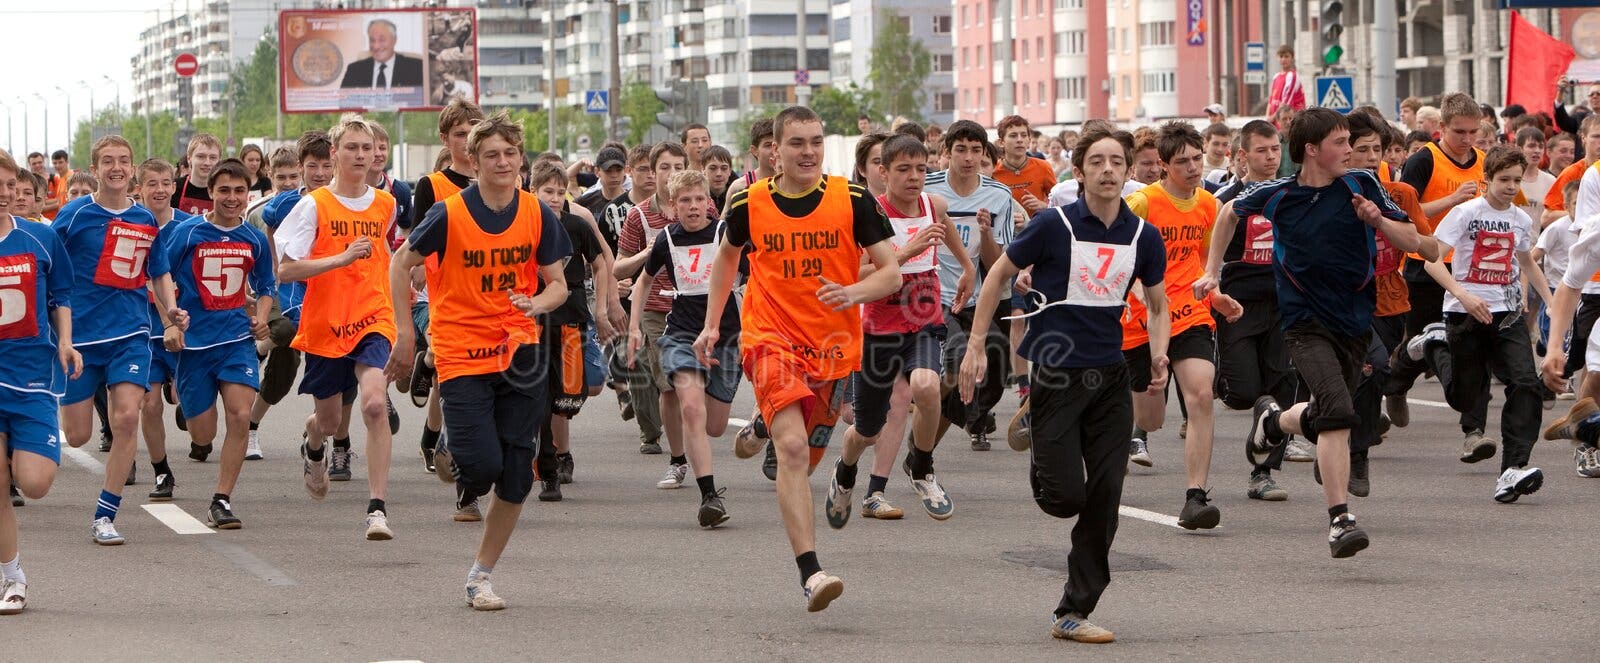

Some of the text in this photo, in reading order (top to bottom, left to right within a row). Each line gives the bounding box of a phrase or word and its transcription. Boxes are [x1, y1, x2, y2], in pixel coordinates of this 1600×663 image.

[331, 221, 348, 237] УО
[763, 230, 839, 252] УО ГОСШ
[1161, 226, 1177, 241] УО
[111, 236, 152, 278] 5
[463, 244, 532, 268] УО ГОСШ
[689, 248, 702, 272] 7
[1095, 247, 1116, 280] 7
[1479, 237, 1511, 271] 2
[201, 257, 244, 297] 5
[801, 258, 823, 277] 29
[482, 271, 516, 293] N 29
